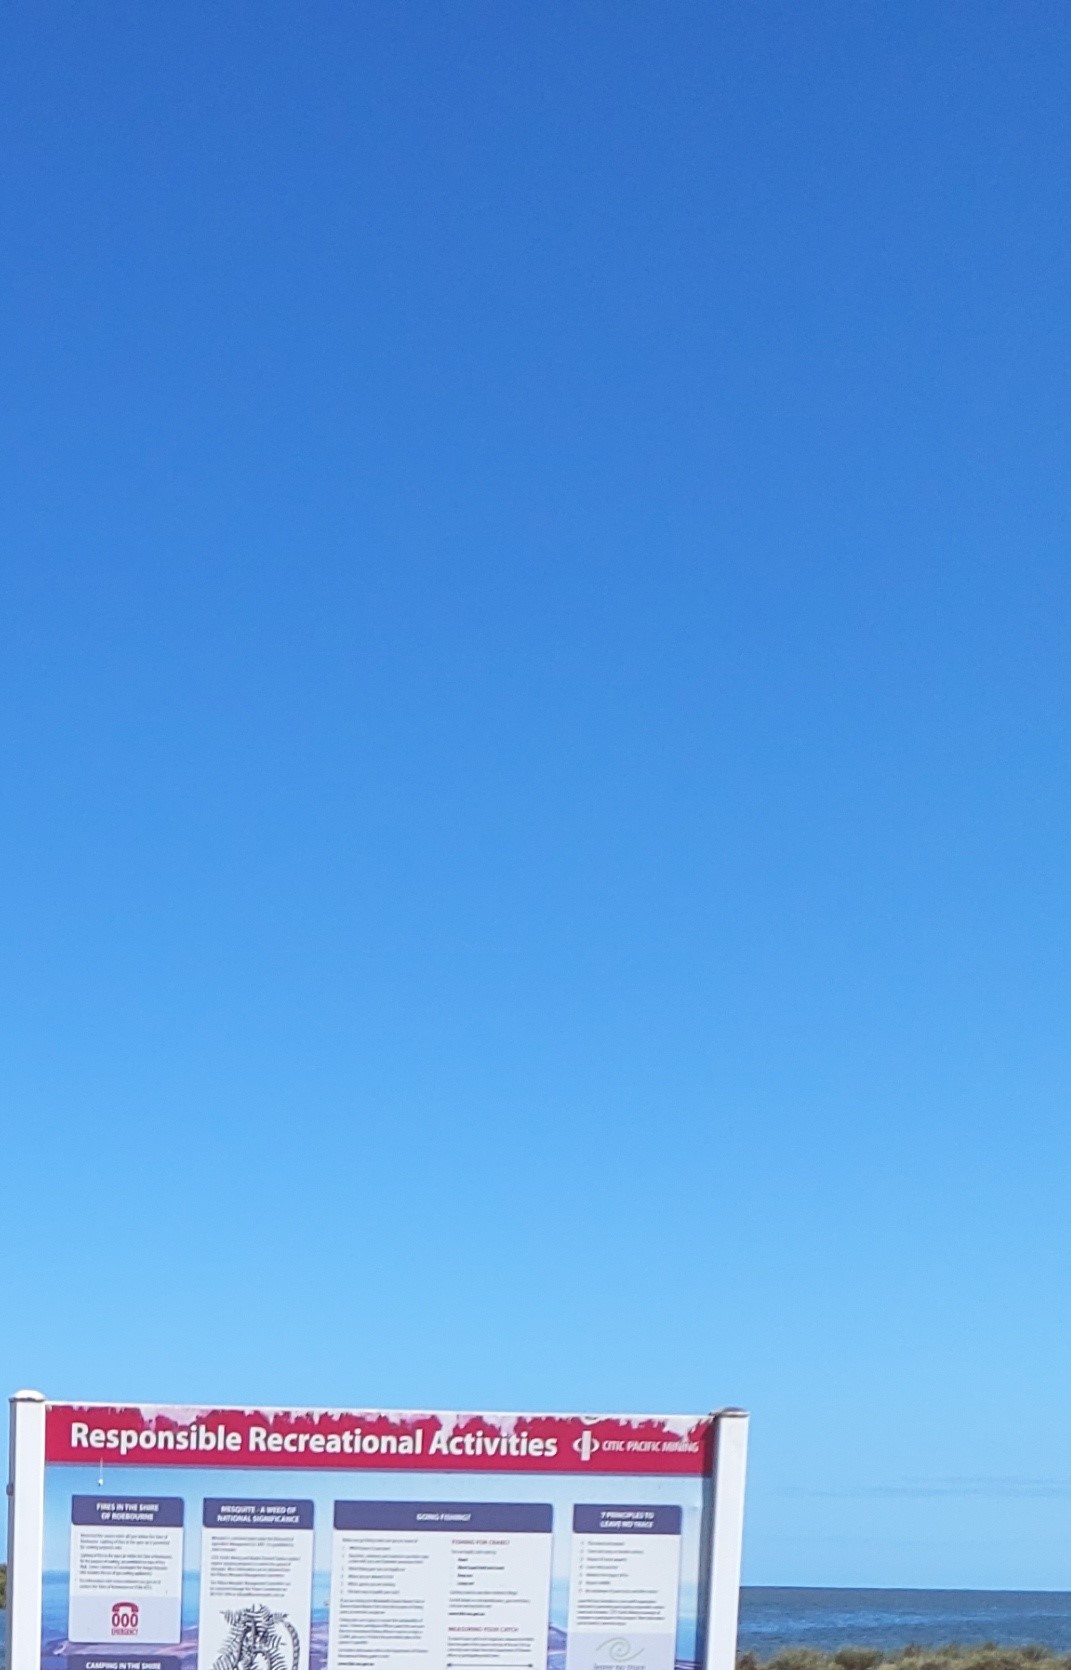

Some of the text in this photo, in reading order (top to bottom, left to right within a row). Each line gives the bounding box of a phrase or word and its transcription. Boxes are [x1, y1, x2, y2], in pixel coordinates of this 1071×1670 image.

[71, 1422, 558, 1457] Responsible Recreational Activities
[602, 1440, 699, 1453] CITIC PACIFIC MINING
[96, 1503, 115, 1511] FIRES
[116, 1503, 124, 1511] IN
[125, 1503, 138, 1511] THE
[221, 1505, 256, 1513] MESQUITE
[267, 1506, 286, 1514] WEED
[287, 1506, 297, 1514] OF
[101, 1512, 110, 1520] OF
[217, 1514, 300, 1523] NATIONAL SIGNIFICANCE
[112, 1613, 138, 1627] 000
[86, 1662, 118, 1670] CAMPING
[128, 1662, 141, 1670] THE
[141, 1662, 161, 1670] SHIRE
